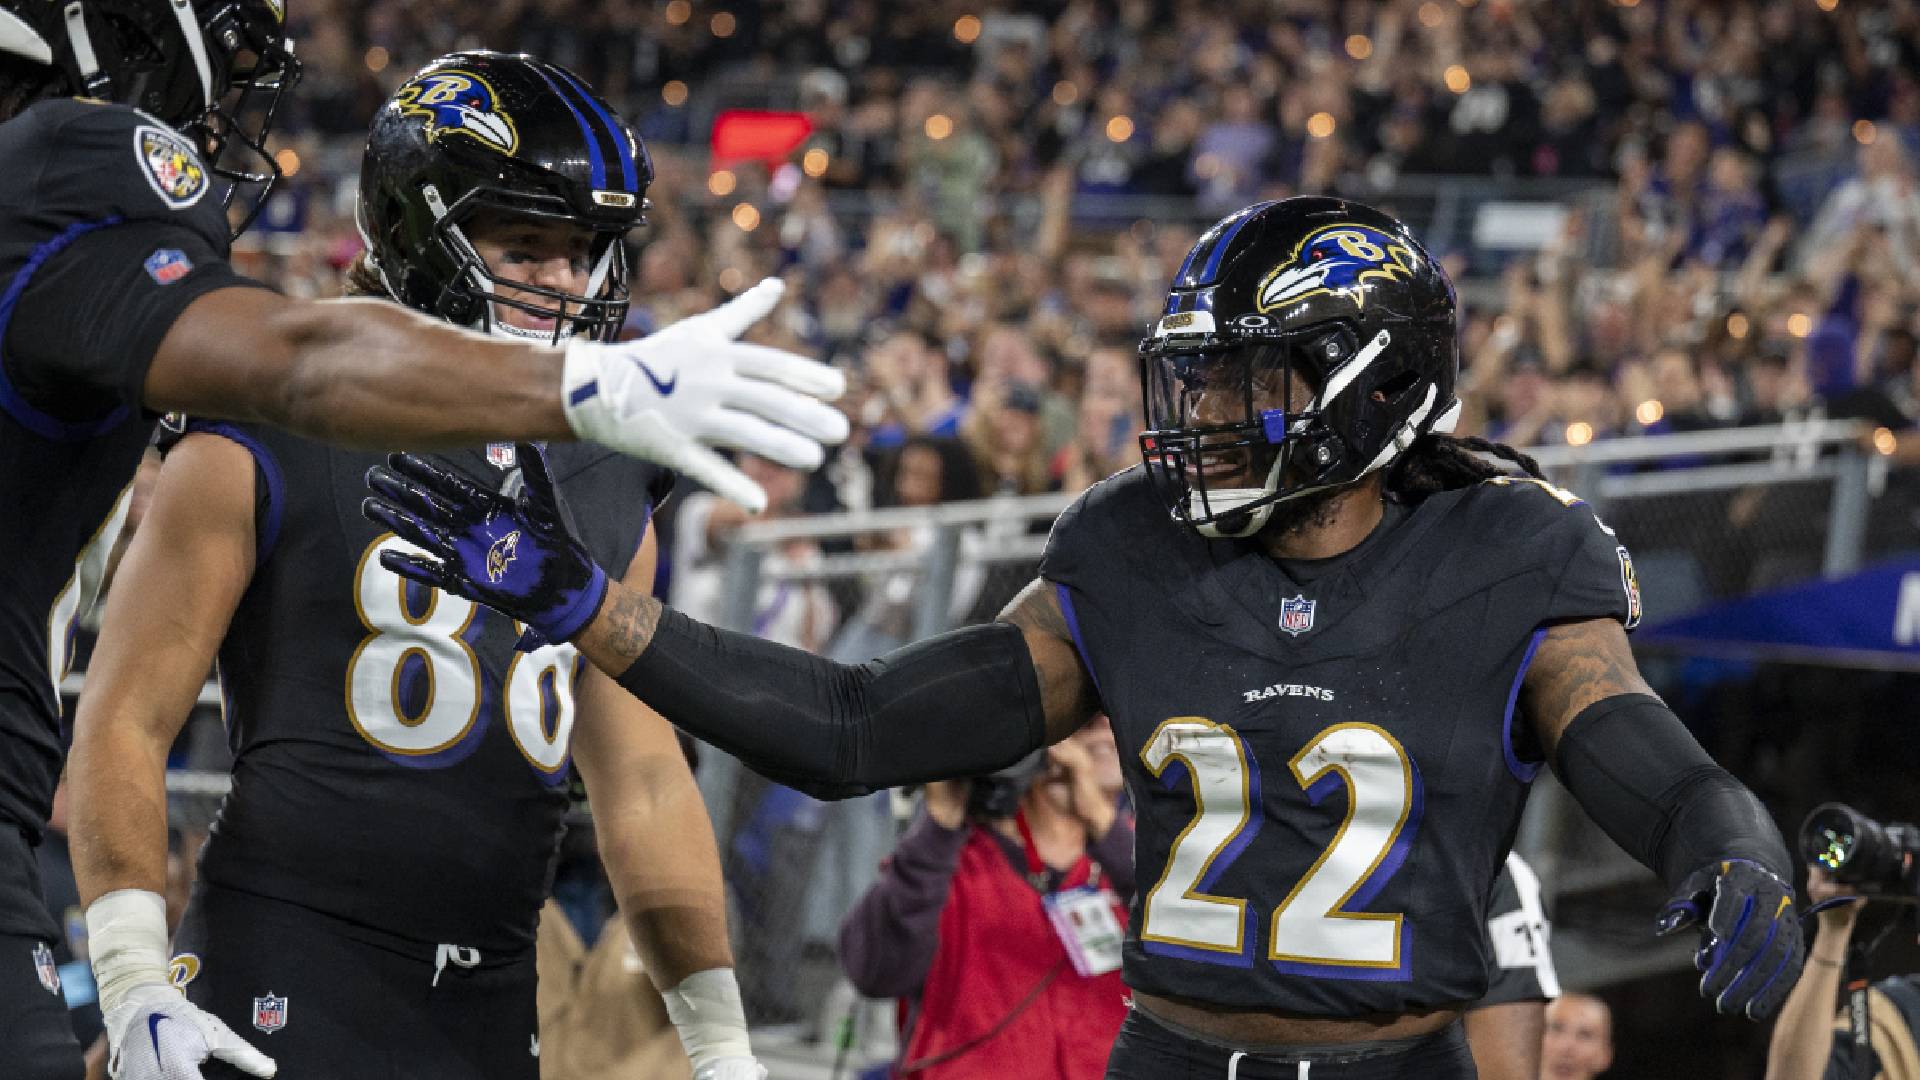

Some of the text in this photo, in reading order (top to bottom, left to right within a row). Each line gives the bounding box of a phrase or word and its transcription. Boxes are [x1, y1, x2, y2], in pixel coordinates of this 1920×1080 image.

[419, 76, 472, 104] B
[1316, 230, 1385, 261] B
[1243, 684, 1335, 703] RAVENS
[1139, 716, 1420, 978] 22
